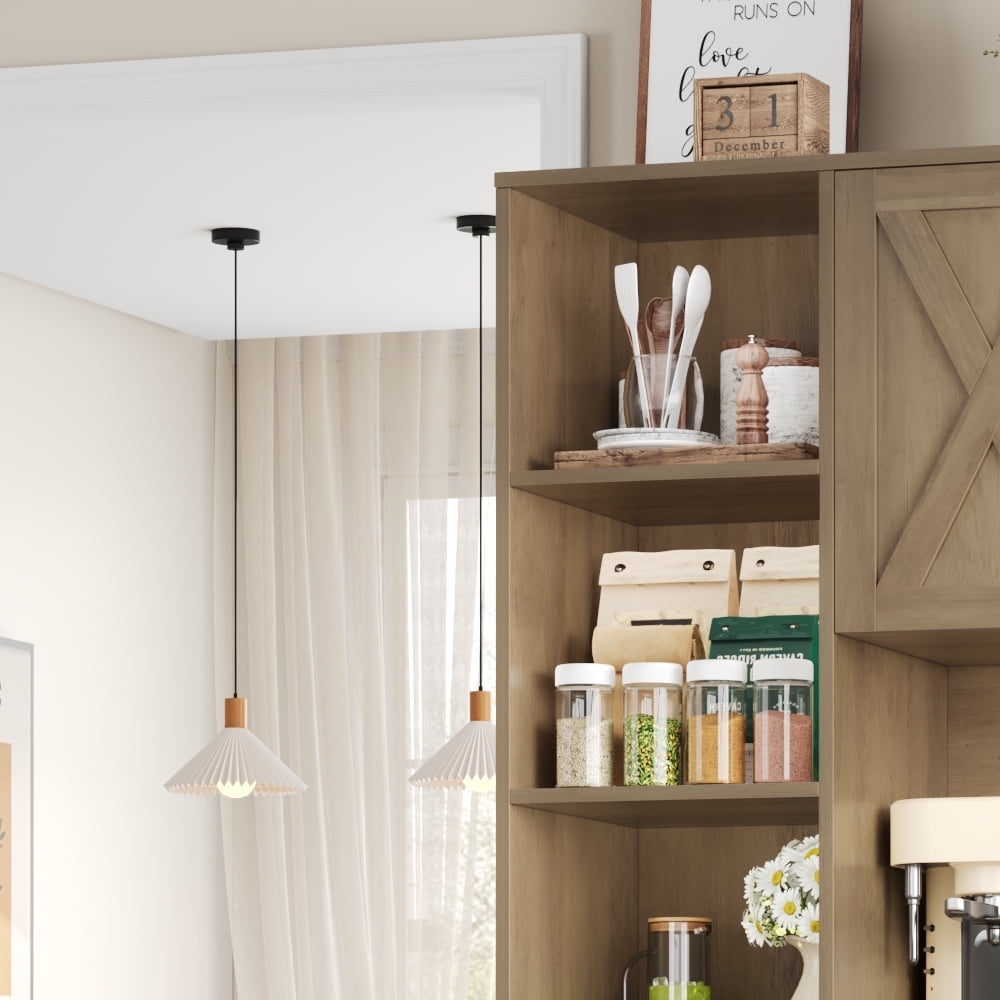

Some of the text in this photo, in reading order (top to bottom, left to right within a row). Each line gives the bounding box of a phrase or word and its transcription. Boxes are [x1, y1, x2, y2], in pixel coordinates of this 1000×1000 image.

[733, 0, 815, 20] RUNS ON
[698, 30, 749, 67] love
[714, 140, 785, 153] December
